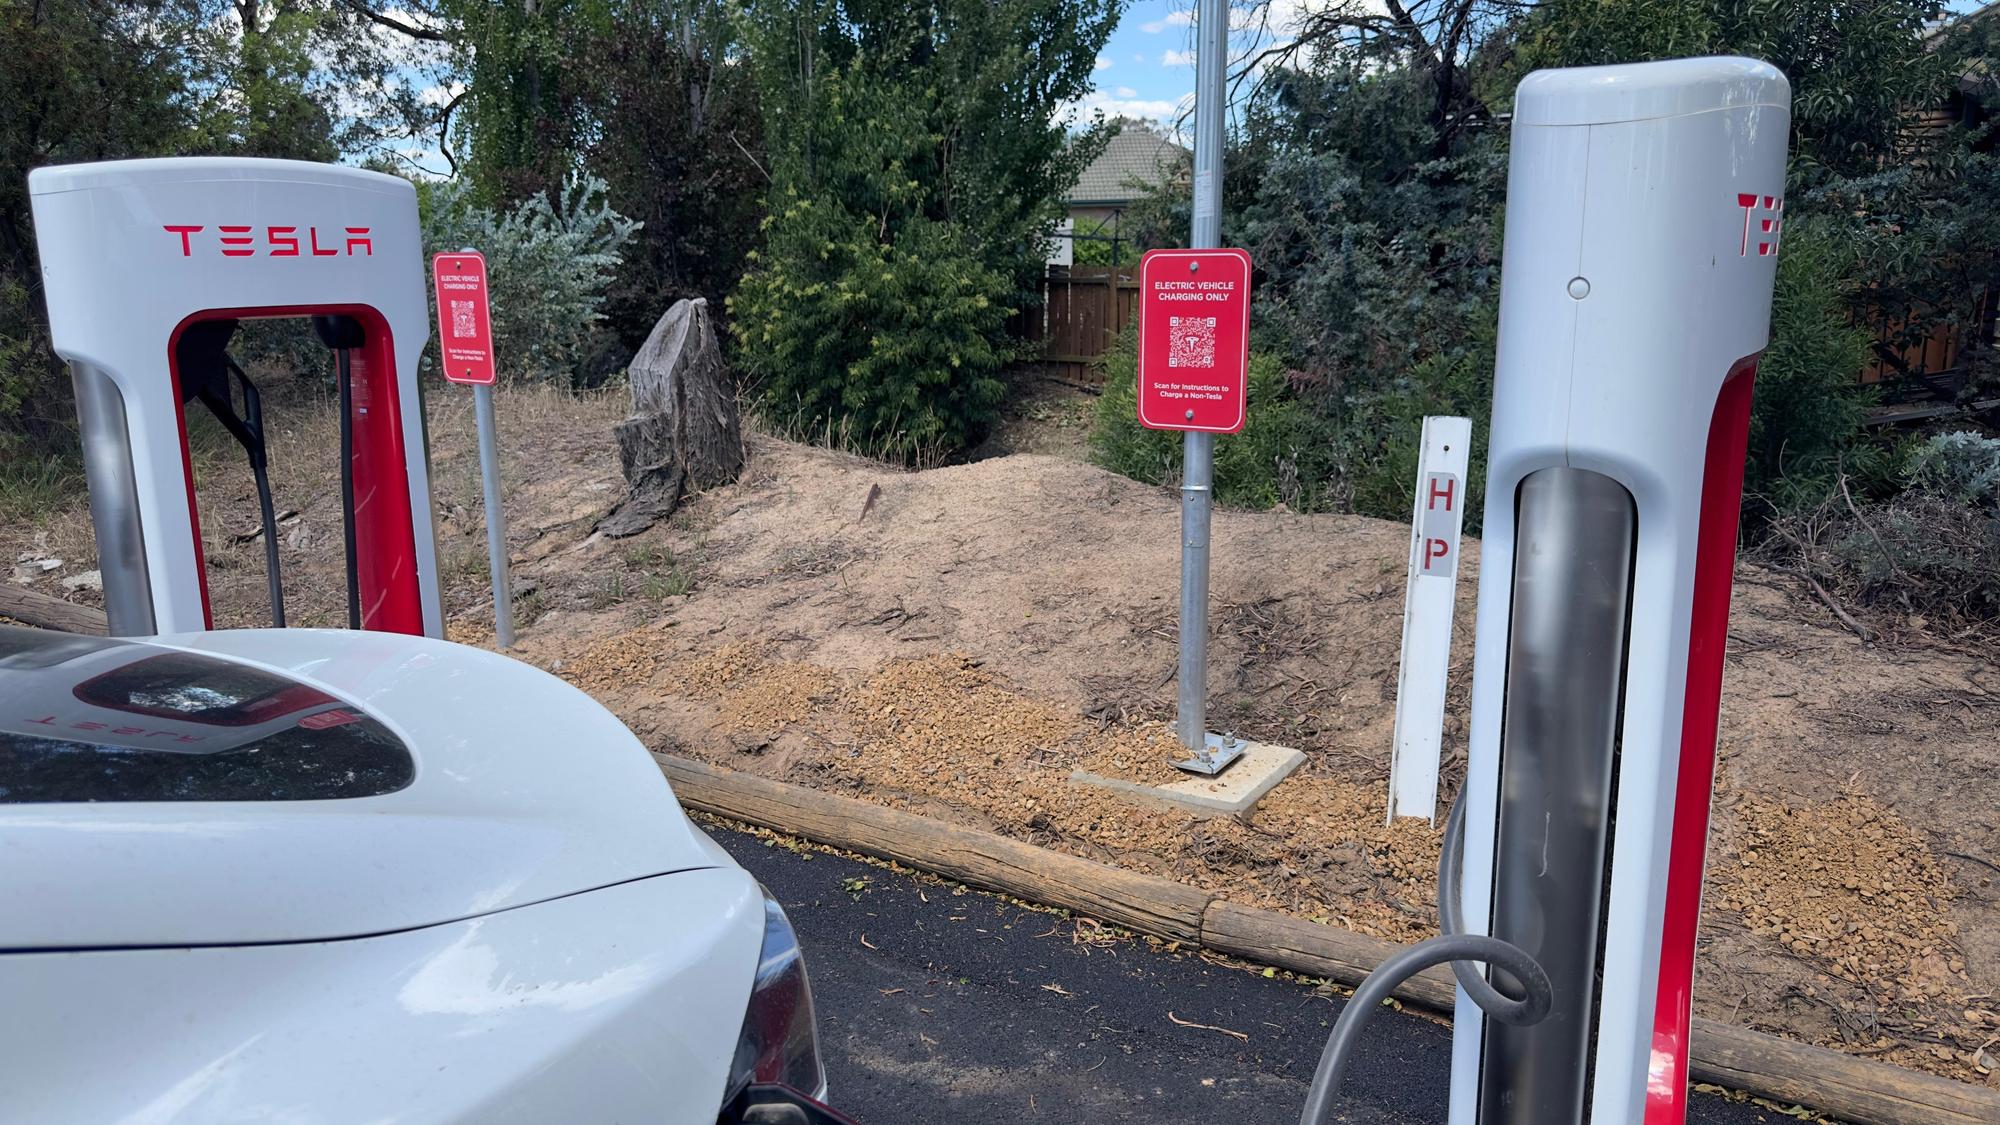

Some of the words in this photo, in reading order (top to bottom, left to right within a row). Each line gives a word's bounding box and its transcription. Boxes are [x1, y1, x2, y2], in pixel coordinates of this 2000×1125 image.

[163, 225, 373, 257] TESLA
[1154, 281, 1195, 290] ELECTRIC
[1197, 281, 1234, 290] VEHICLE
[1158, 292, 1204, 301] CHARGING
[1205, 292, 1229, 301] ONLY
[1181, 383, 1220, 392] Instructions
[1159, 391, 1183, 399] Charge
[1190, 392, 1223, 400] Non-Tesla
[1428, 478, 1454, 511] H
[1424, 538, 1449, 570] P
